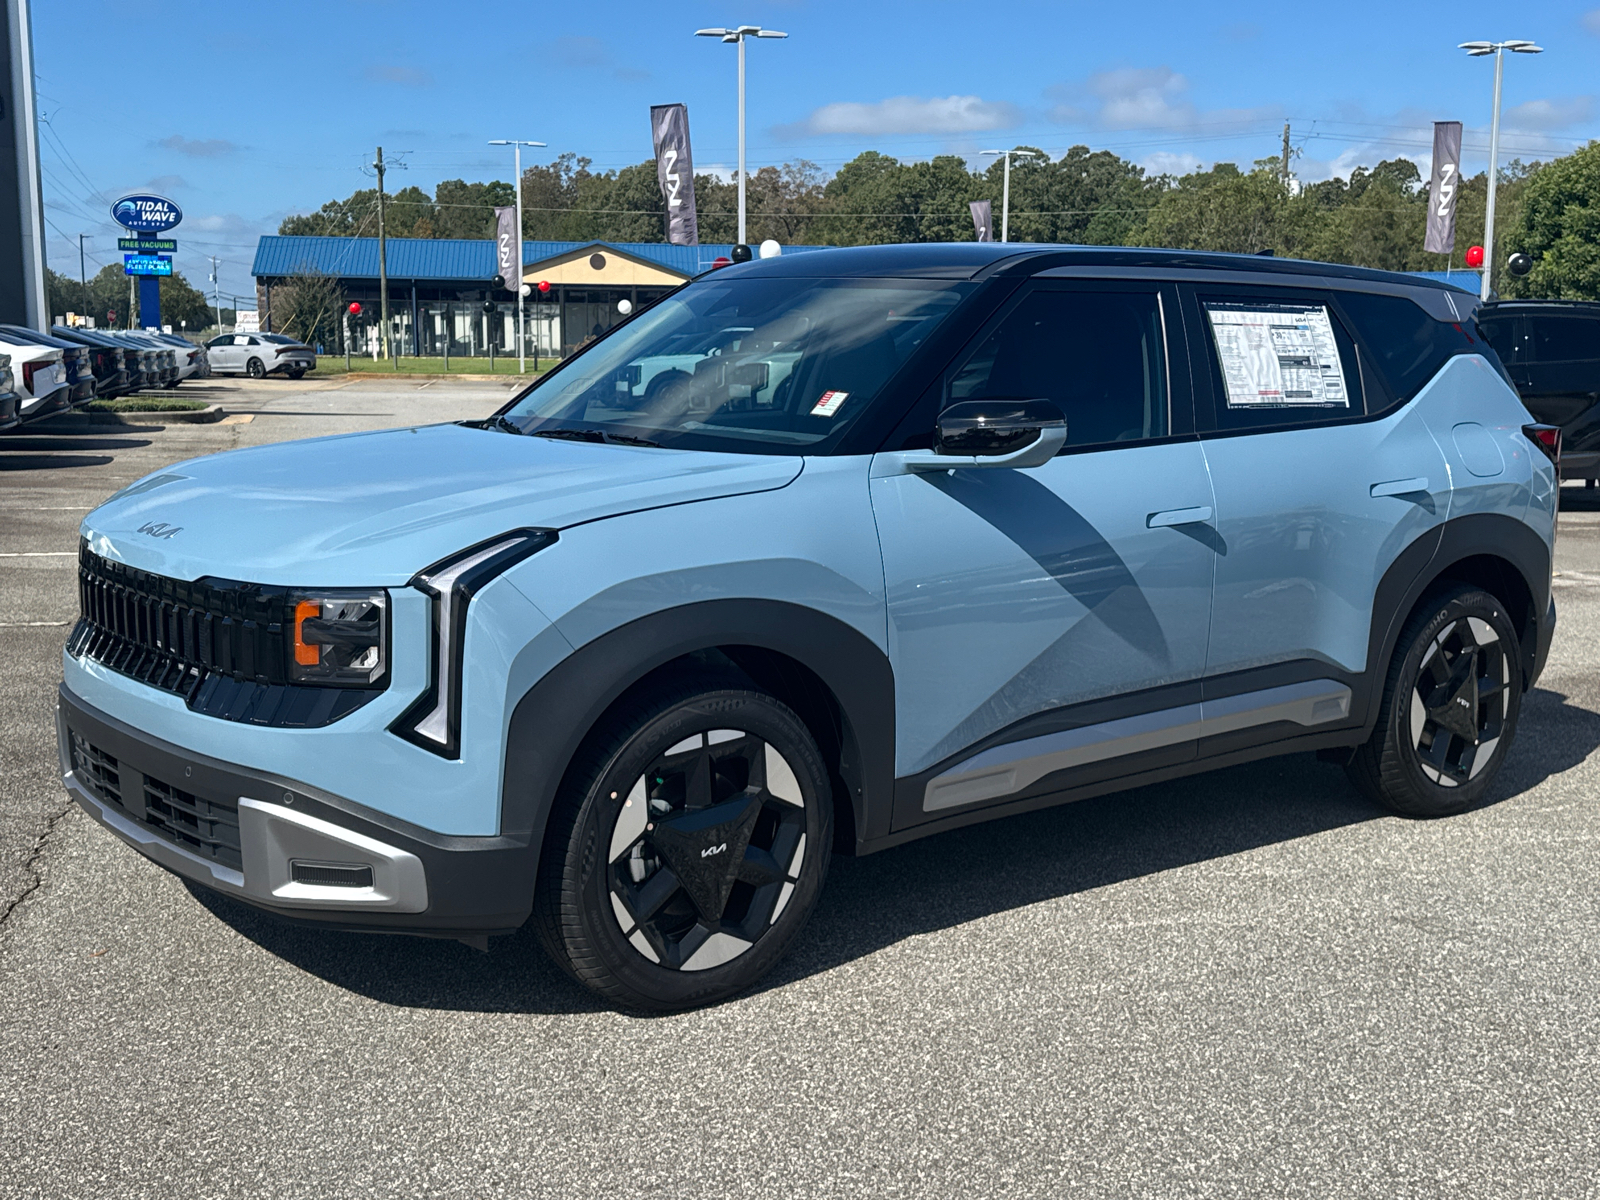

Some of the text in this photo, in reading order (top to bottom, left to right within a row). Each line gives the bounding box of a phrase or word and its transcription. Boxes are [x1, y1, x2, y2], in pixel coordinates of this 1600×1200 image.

[136, 201, 169, 212] TIDAL
[141, 211, 176, 222] WAVE
[120, 240, 174, 249] FREE VACUUMS
[1414, 609, 1448, 657] KUMHO
[700, 842, 727, 858] KIA
